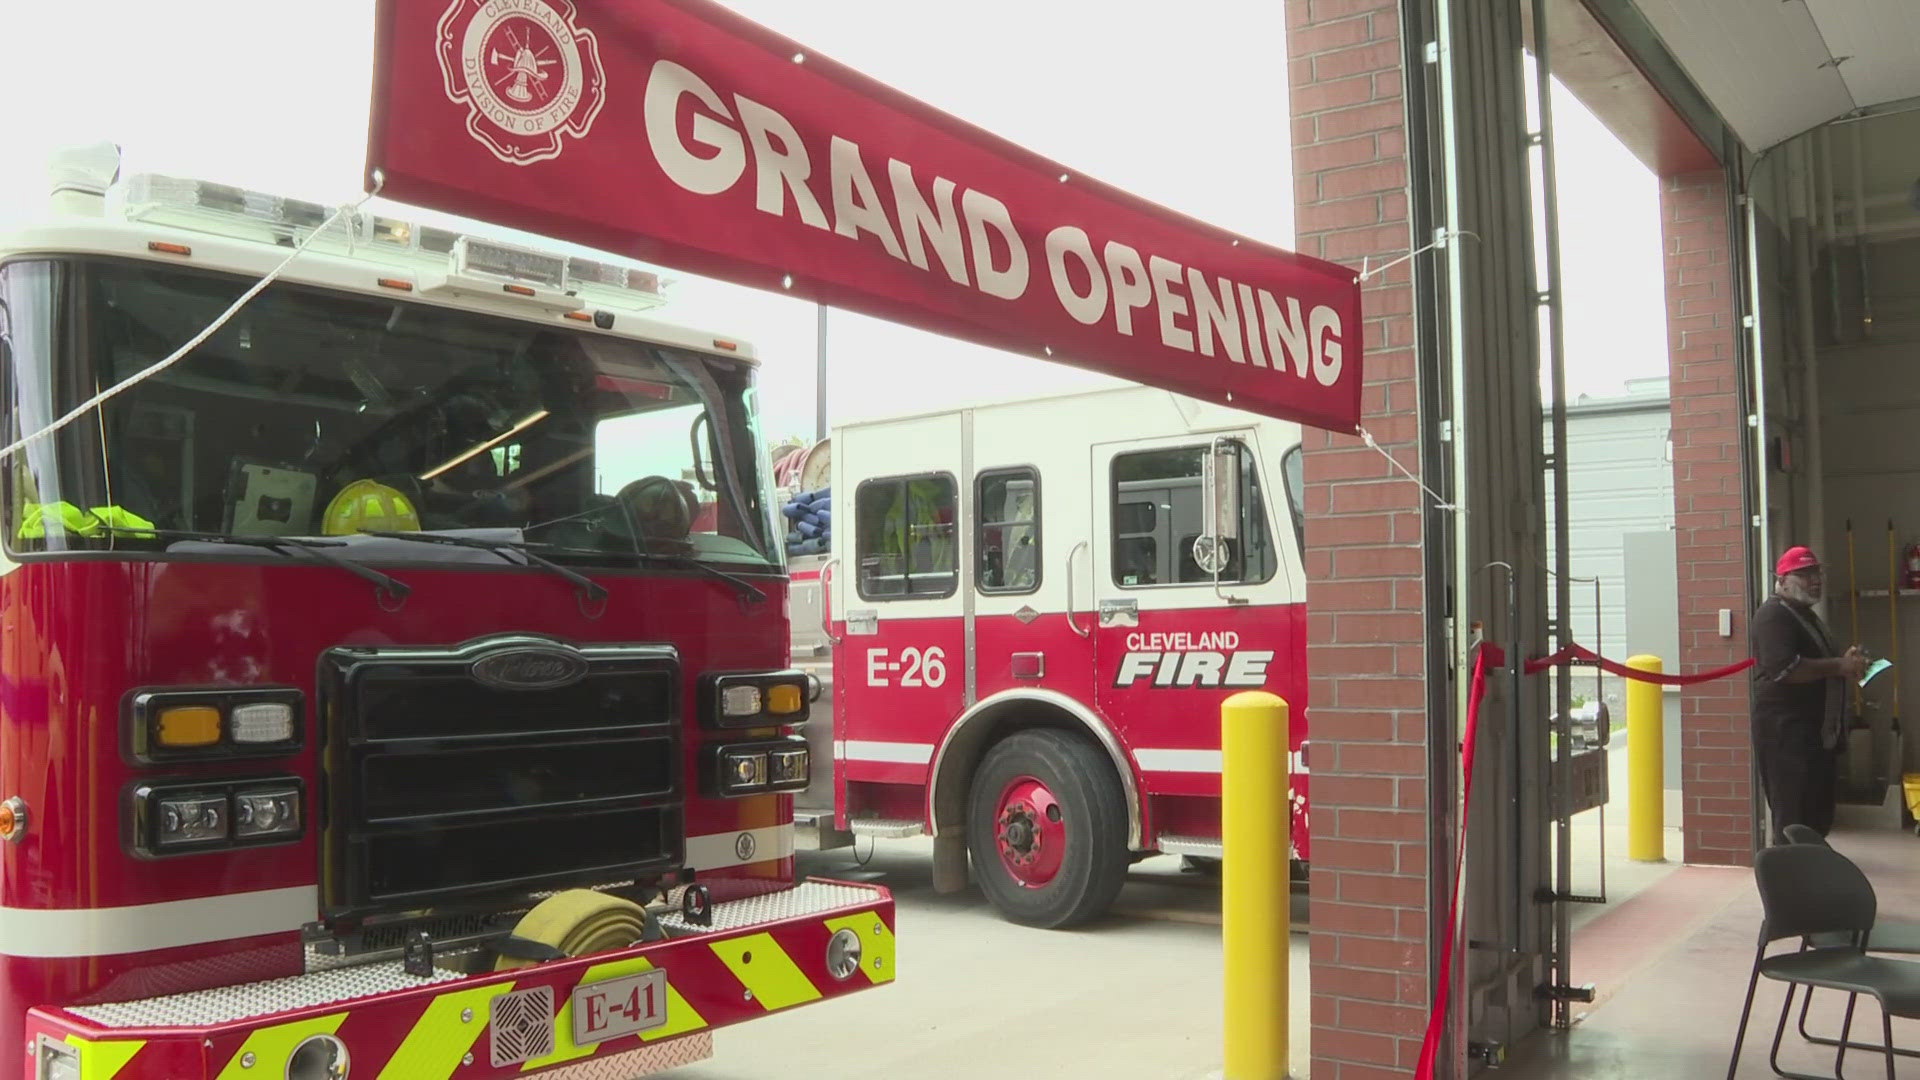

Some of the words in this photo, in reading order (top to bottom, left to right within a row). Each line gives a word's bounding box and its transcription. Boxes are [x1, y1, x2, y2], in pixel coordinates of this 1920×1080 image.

[485, 0, 571, 45] CLEVELAND
[465, 57, 516, 129] DIVISION
[524, 117, 545, 131] OF
[552, 85, 578, 123] FIRE
[644, 59, 1029, 300] GRAND
[1045, 226, 1342, 386] OPENING
[1126, 631, 1239, 651] CLEVELAND
[867, 646, 946, 688] E-26
[1112, 651, 1275, 688] FIRE
[583, 983, 656, 1033] E-41
